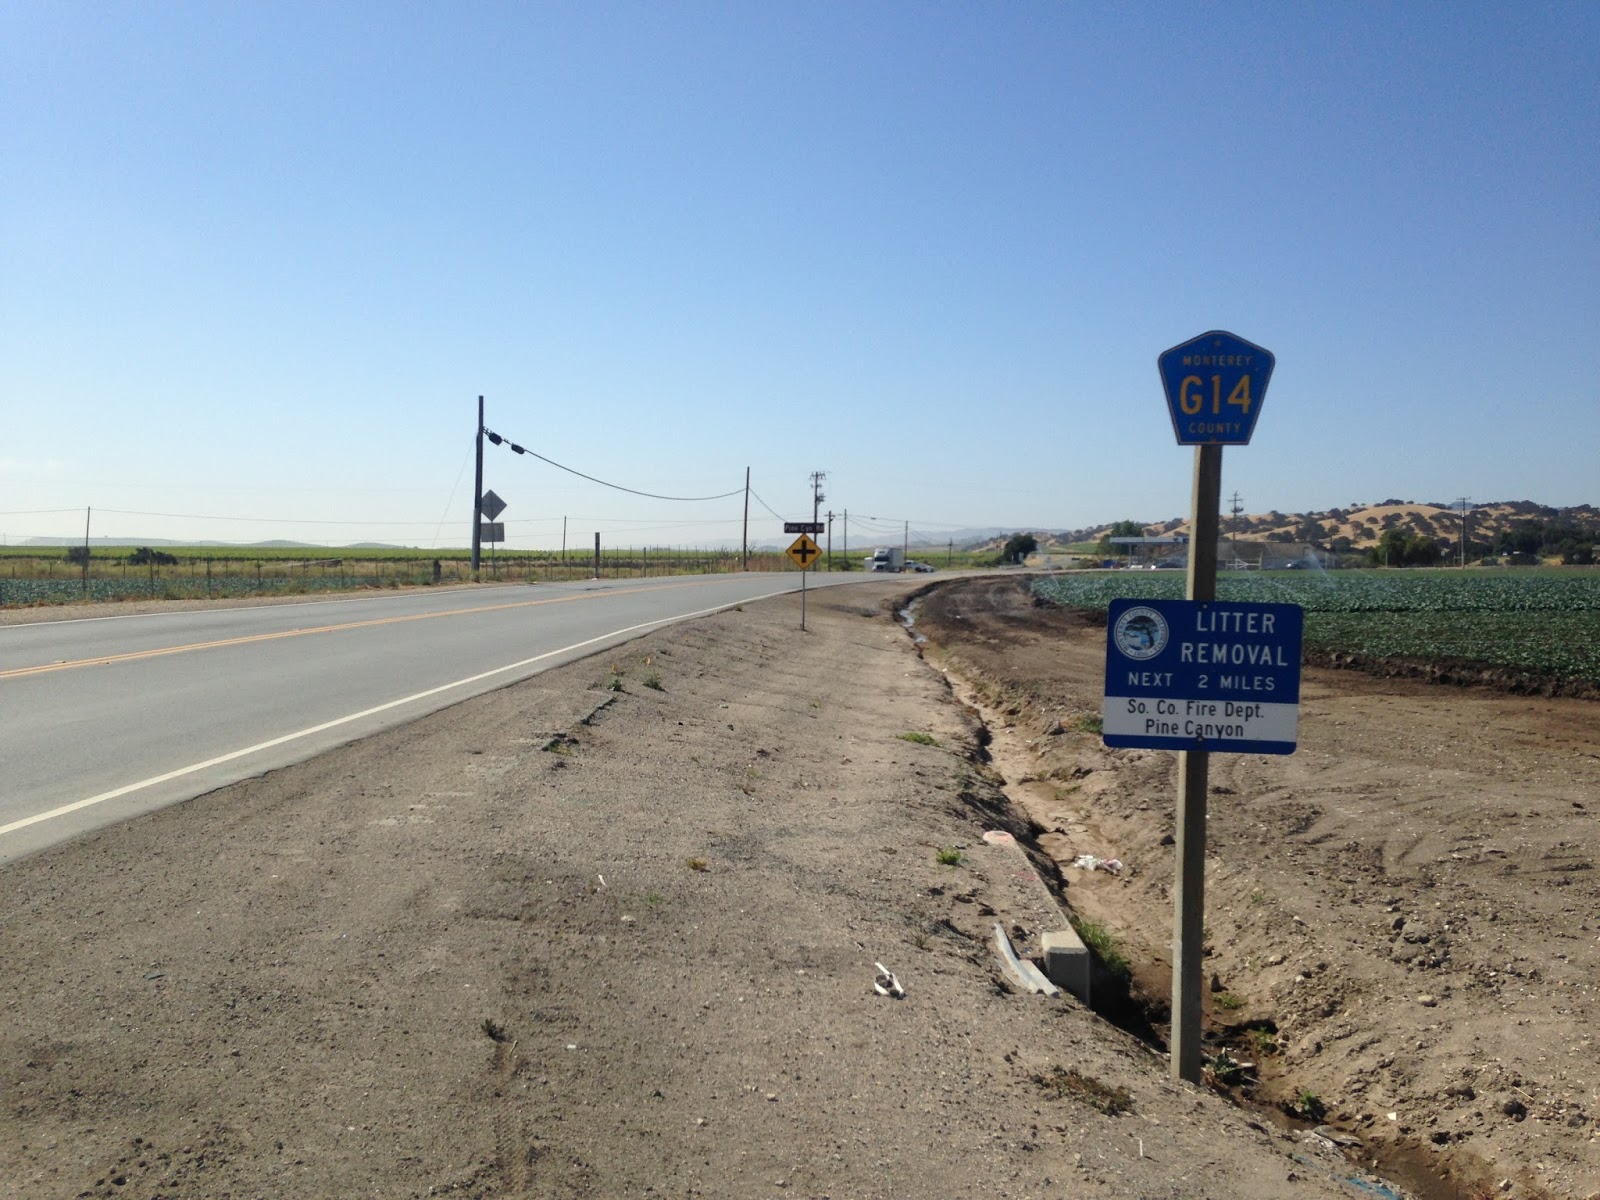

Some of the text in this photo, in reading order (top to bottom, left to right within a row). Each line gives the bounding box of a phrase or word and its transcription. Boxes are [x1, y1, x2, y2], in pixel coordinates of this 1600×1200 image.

[1183, 355, 1252, 366] MONTEREY
[1180, 374, 1251, 415] G14
[1189, 422, 1241, 433] COUNTY
[1196, 611, 1276, 635] LITTER
[1181, 642, 1289, 667] REMOVAL
[1128, 671, 1276, 691] NEXT 2 MILES
[1127, 699, 1265, 722] So. Co. Fire Dept.
[1145, 719, 1245, 739] Pine Canyon
